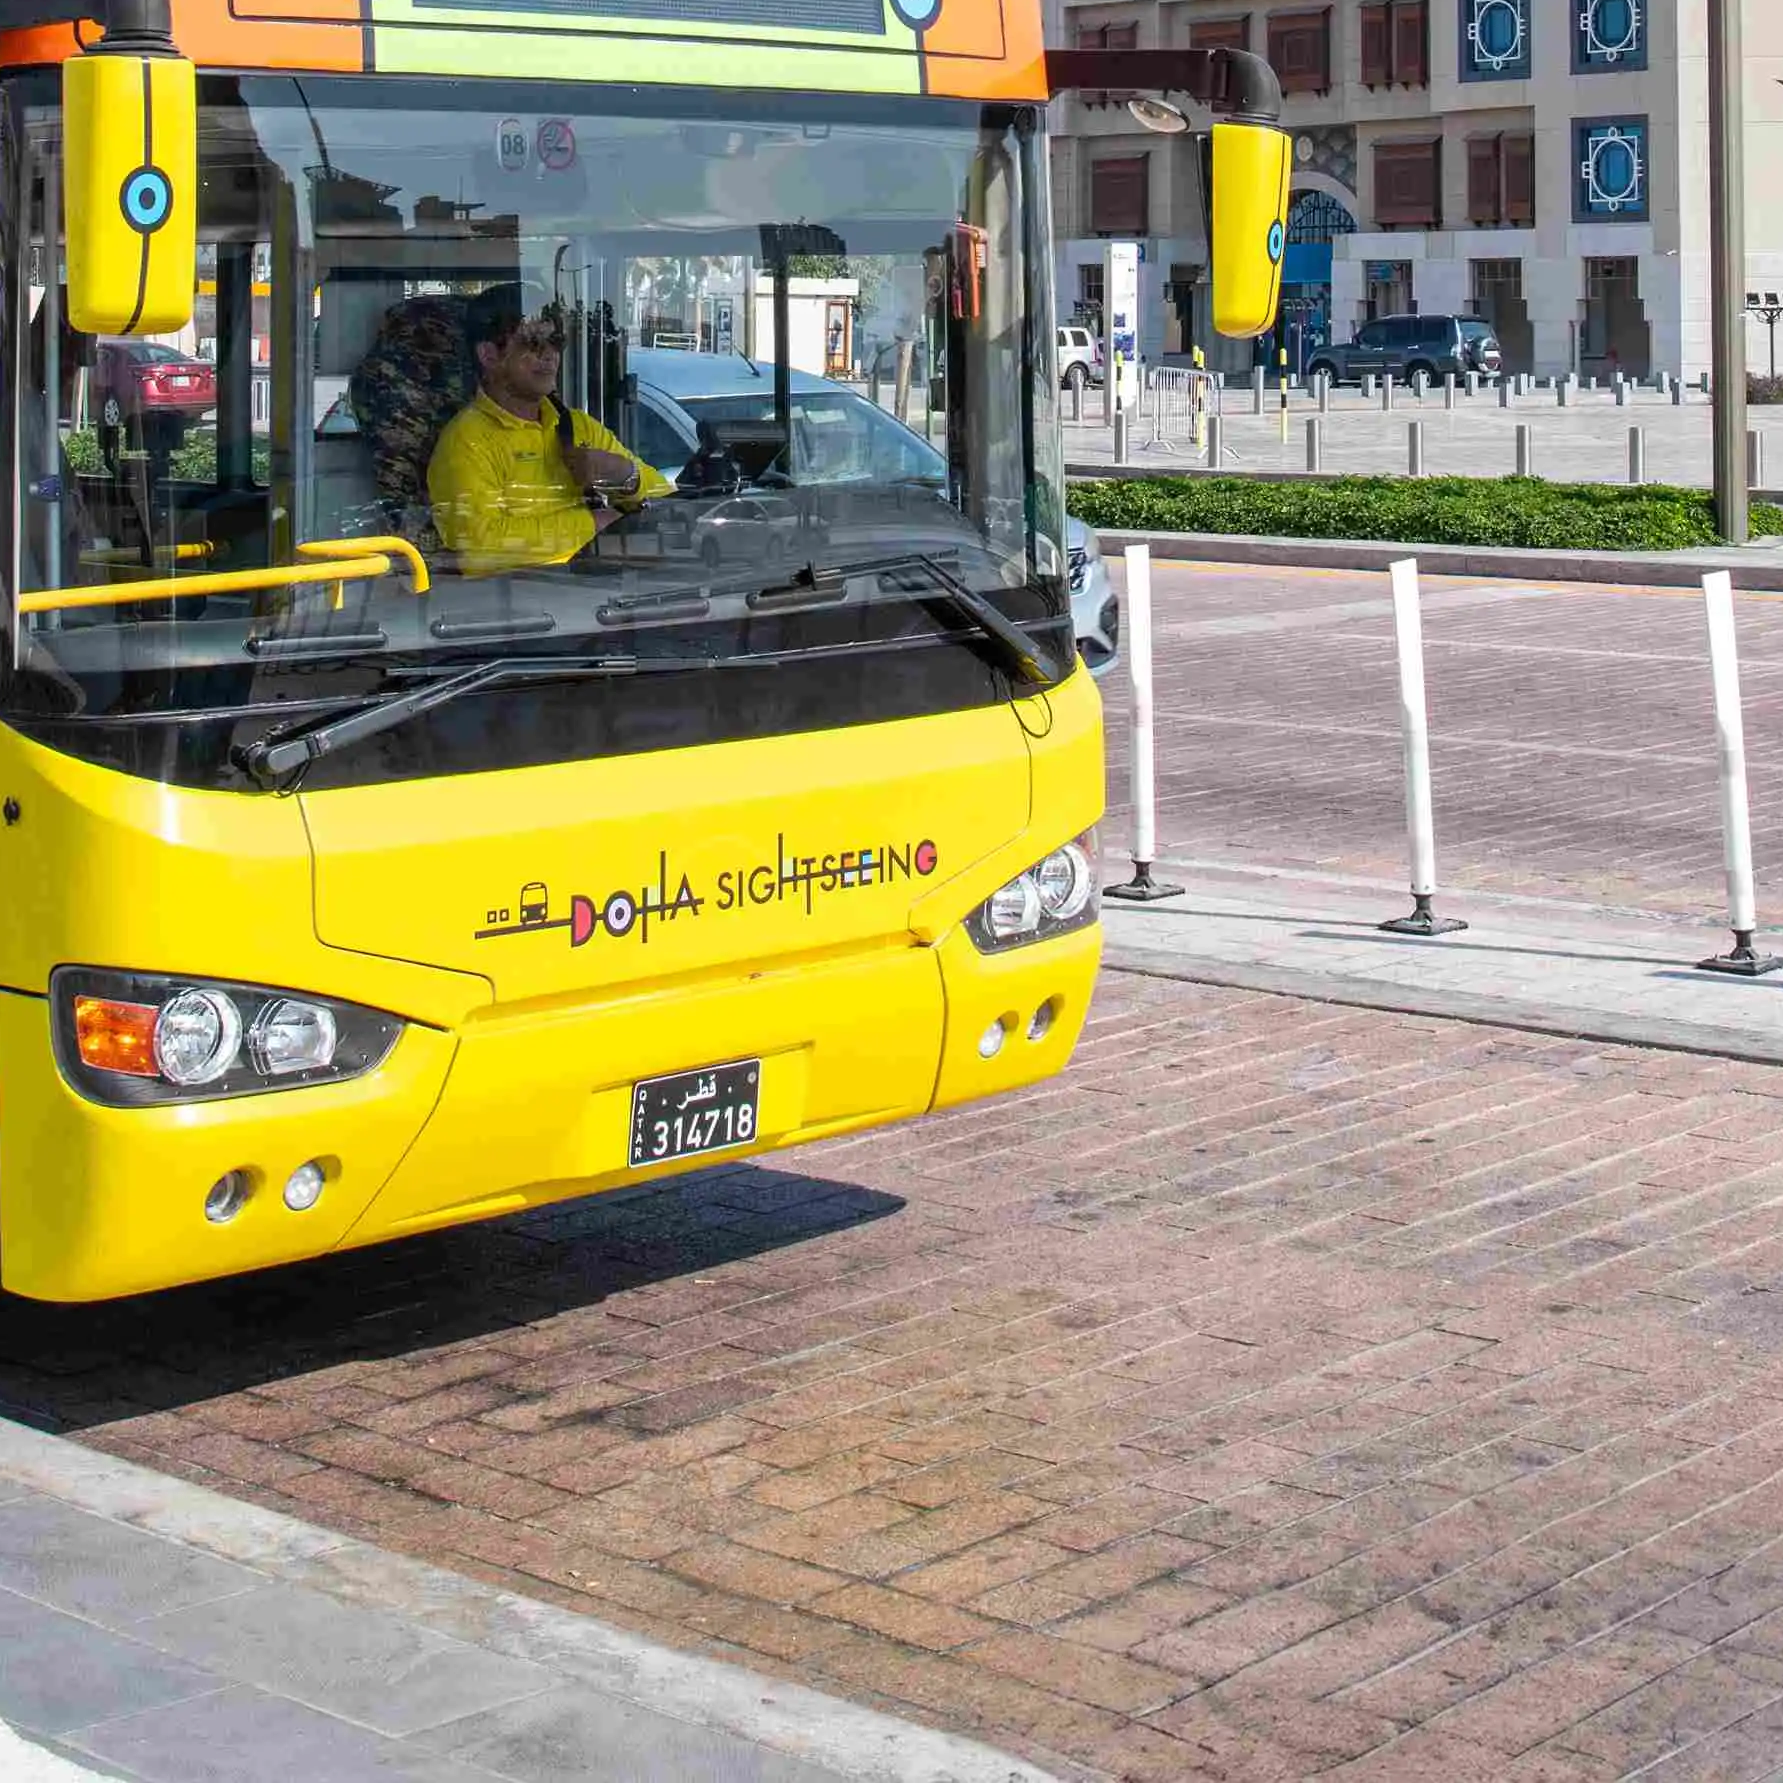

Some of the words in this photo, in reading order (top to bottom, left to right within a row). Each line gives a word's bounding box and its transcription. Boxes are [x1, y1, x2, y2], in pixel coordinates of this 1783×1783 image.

[502, 134, 524, 154] 08
[571, 851, 704, 947] DOHA
[716, 833, 938, 915] SIGHTSEEING
[675, 1074, 718, 1110] قطر
[634, 1089, 648, 1160] QATAR
[652, 1103, 753, 1156] 314718
